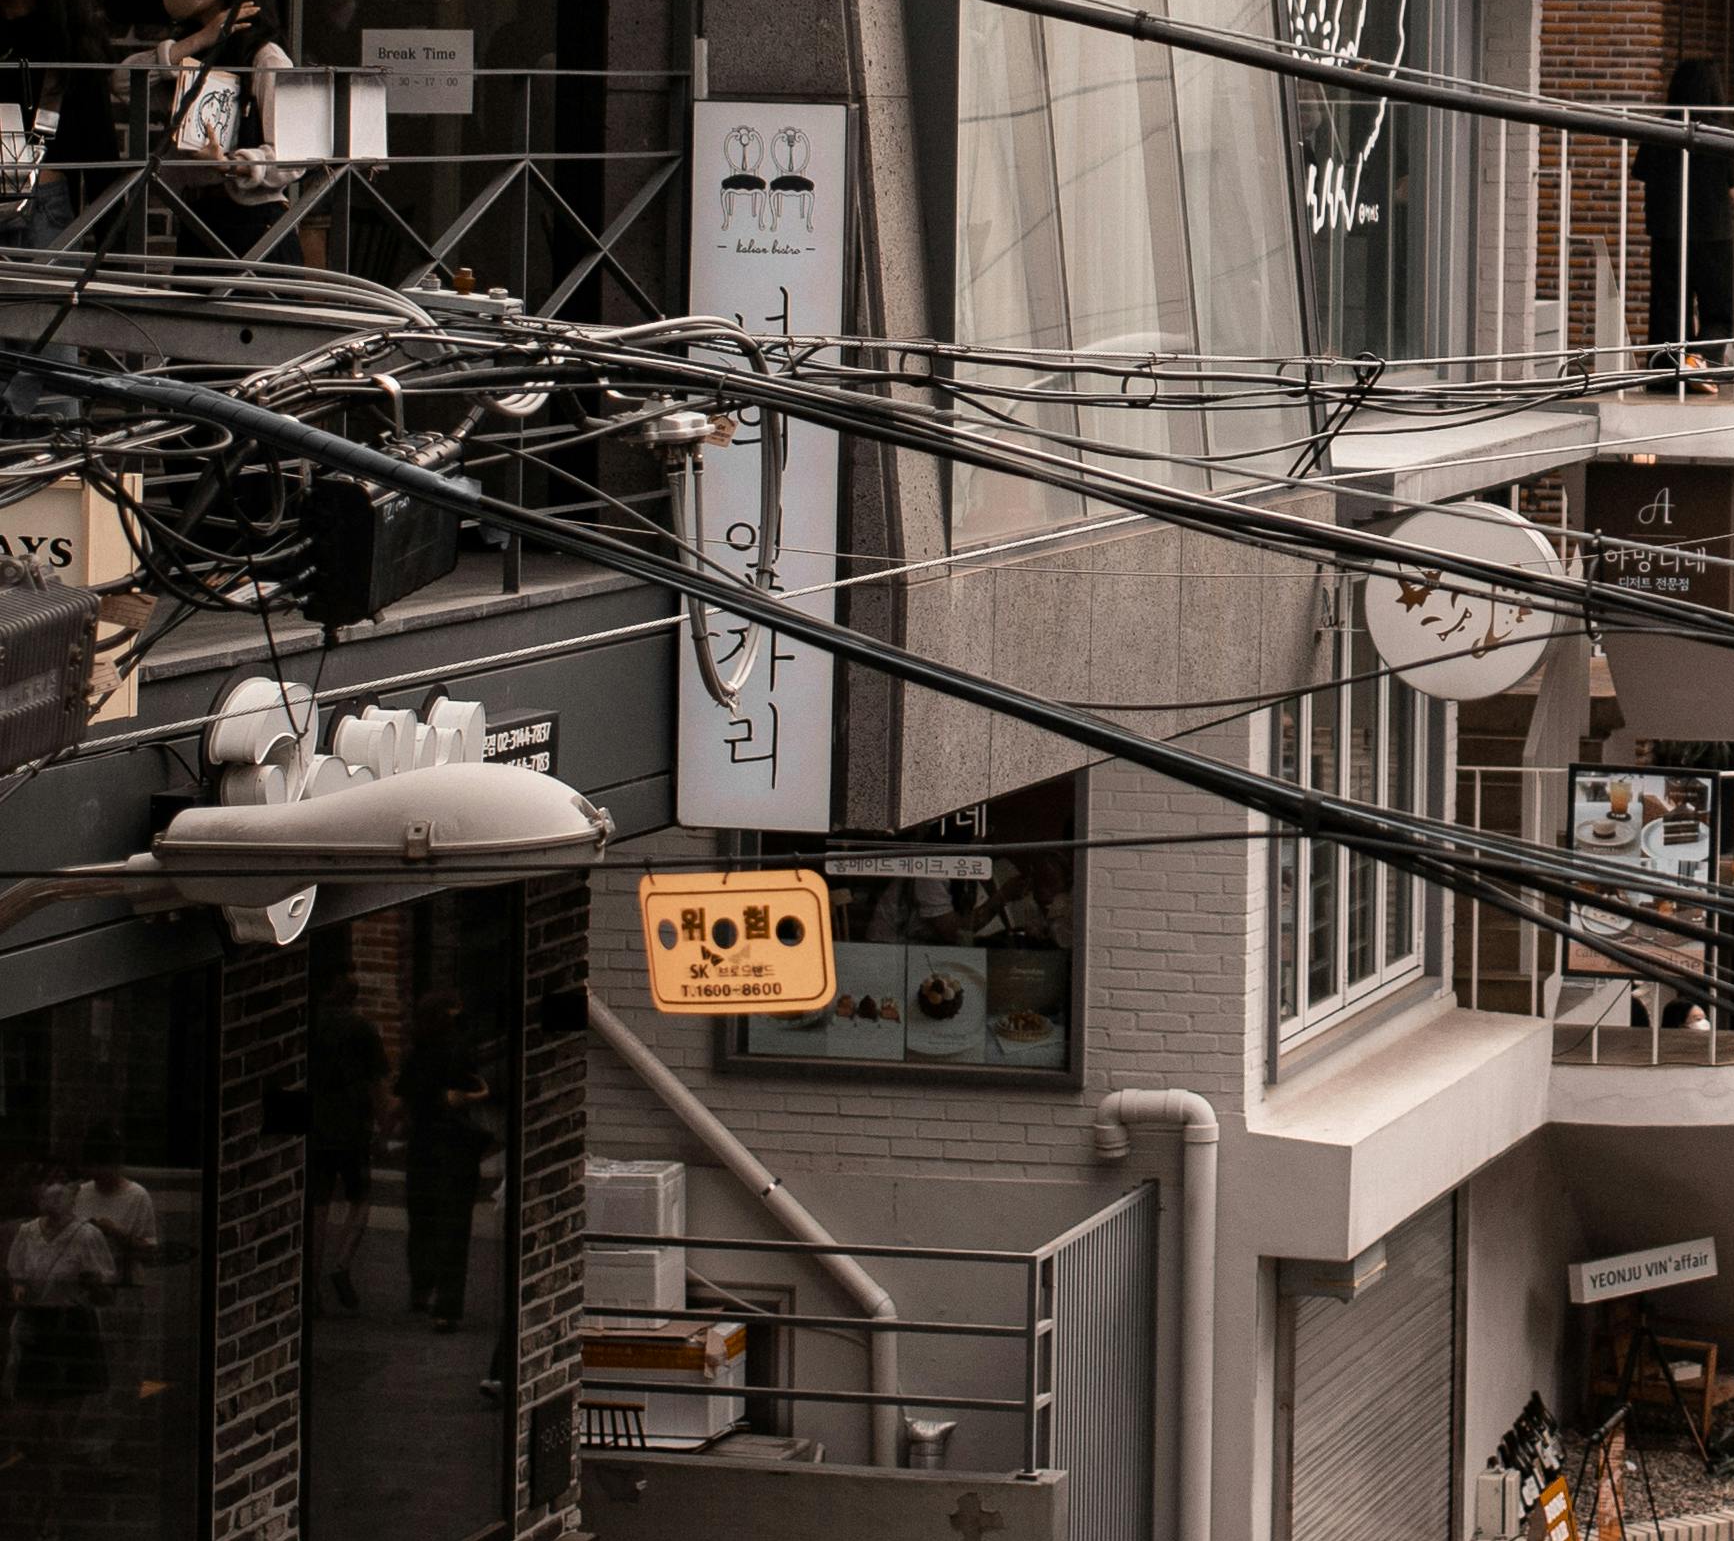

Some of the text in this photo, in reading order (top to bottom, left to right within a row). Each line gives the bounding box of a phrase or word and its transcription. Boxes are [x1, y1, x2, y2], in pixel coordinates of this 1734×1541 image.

[378, 47, 456, 60] Break Time
[1638, 487, 1676, 524] A
[1618, 576, 1690, 591] 디저트 전문점
[954, 860, 985, 877] 음료
[690, 963, 710, 979] SK
[1589, 1265, 1642, 1290] YEONJU
